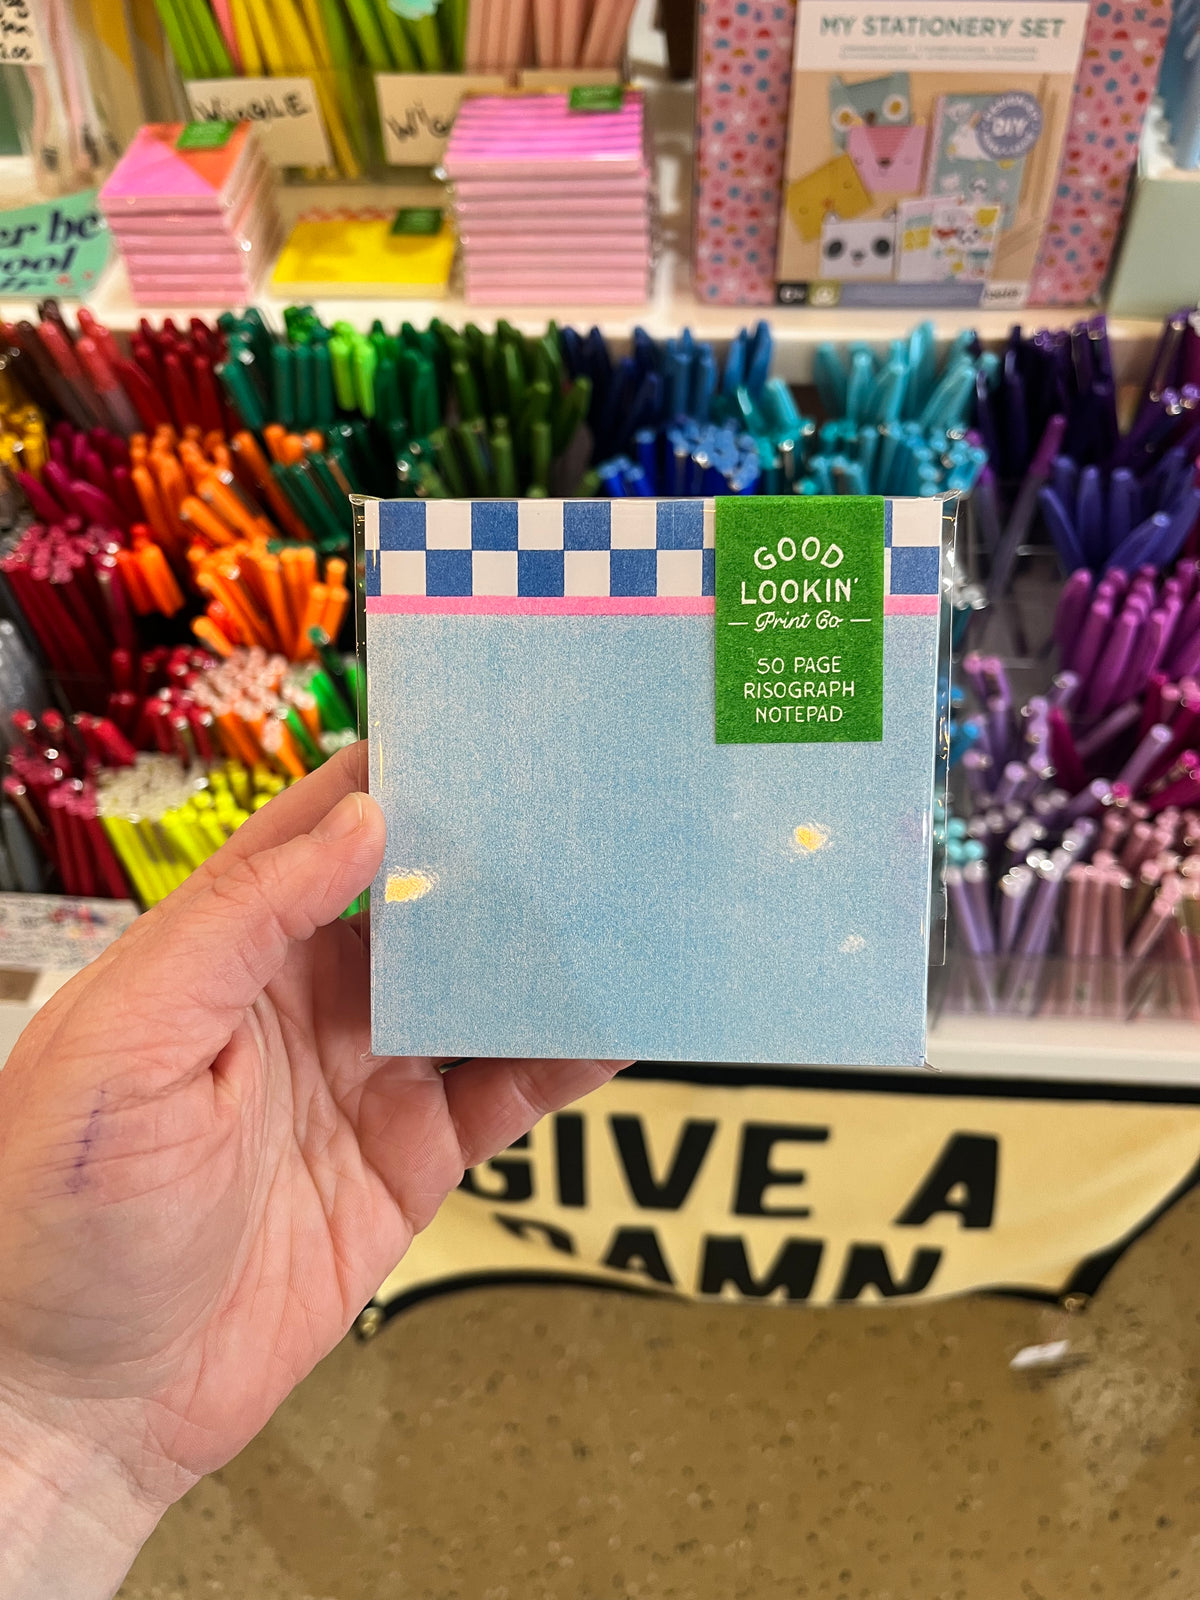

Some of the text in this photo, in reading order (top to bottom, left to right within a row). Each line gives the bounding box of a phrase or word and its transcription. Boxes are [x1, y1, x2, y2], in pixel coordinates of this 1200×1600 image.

[819, 15, 1066, 39] MY STATIONERY SET
[992, 118, 1028, 137] DIY
[753, 536, 844, 570] GOOD
[740, 577, 859, 605] LOOKIN'
[753, 611, 812, 632] Print
[756, 656, 842, 675] 50 PAGE
[743, 681, 855, 699] RISOGRAPH
[755, 706, 843, 723] NOTEPAD
[893, 1129, 1000, 1230] A
